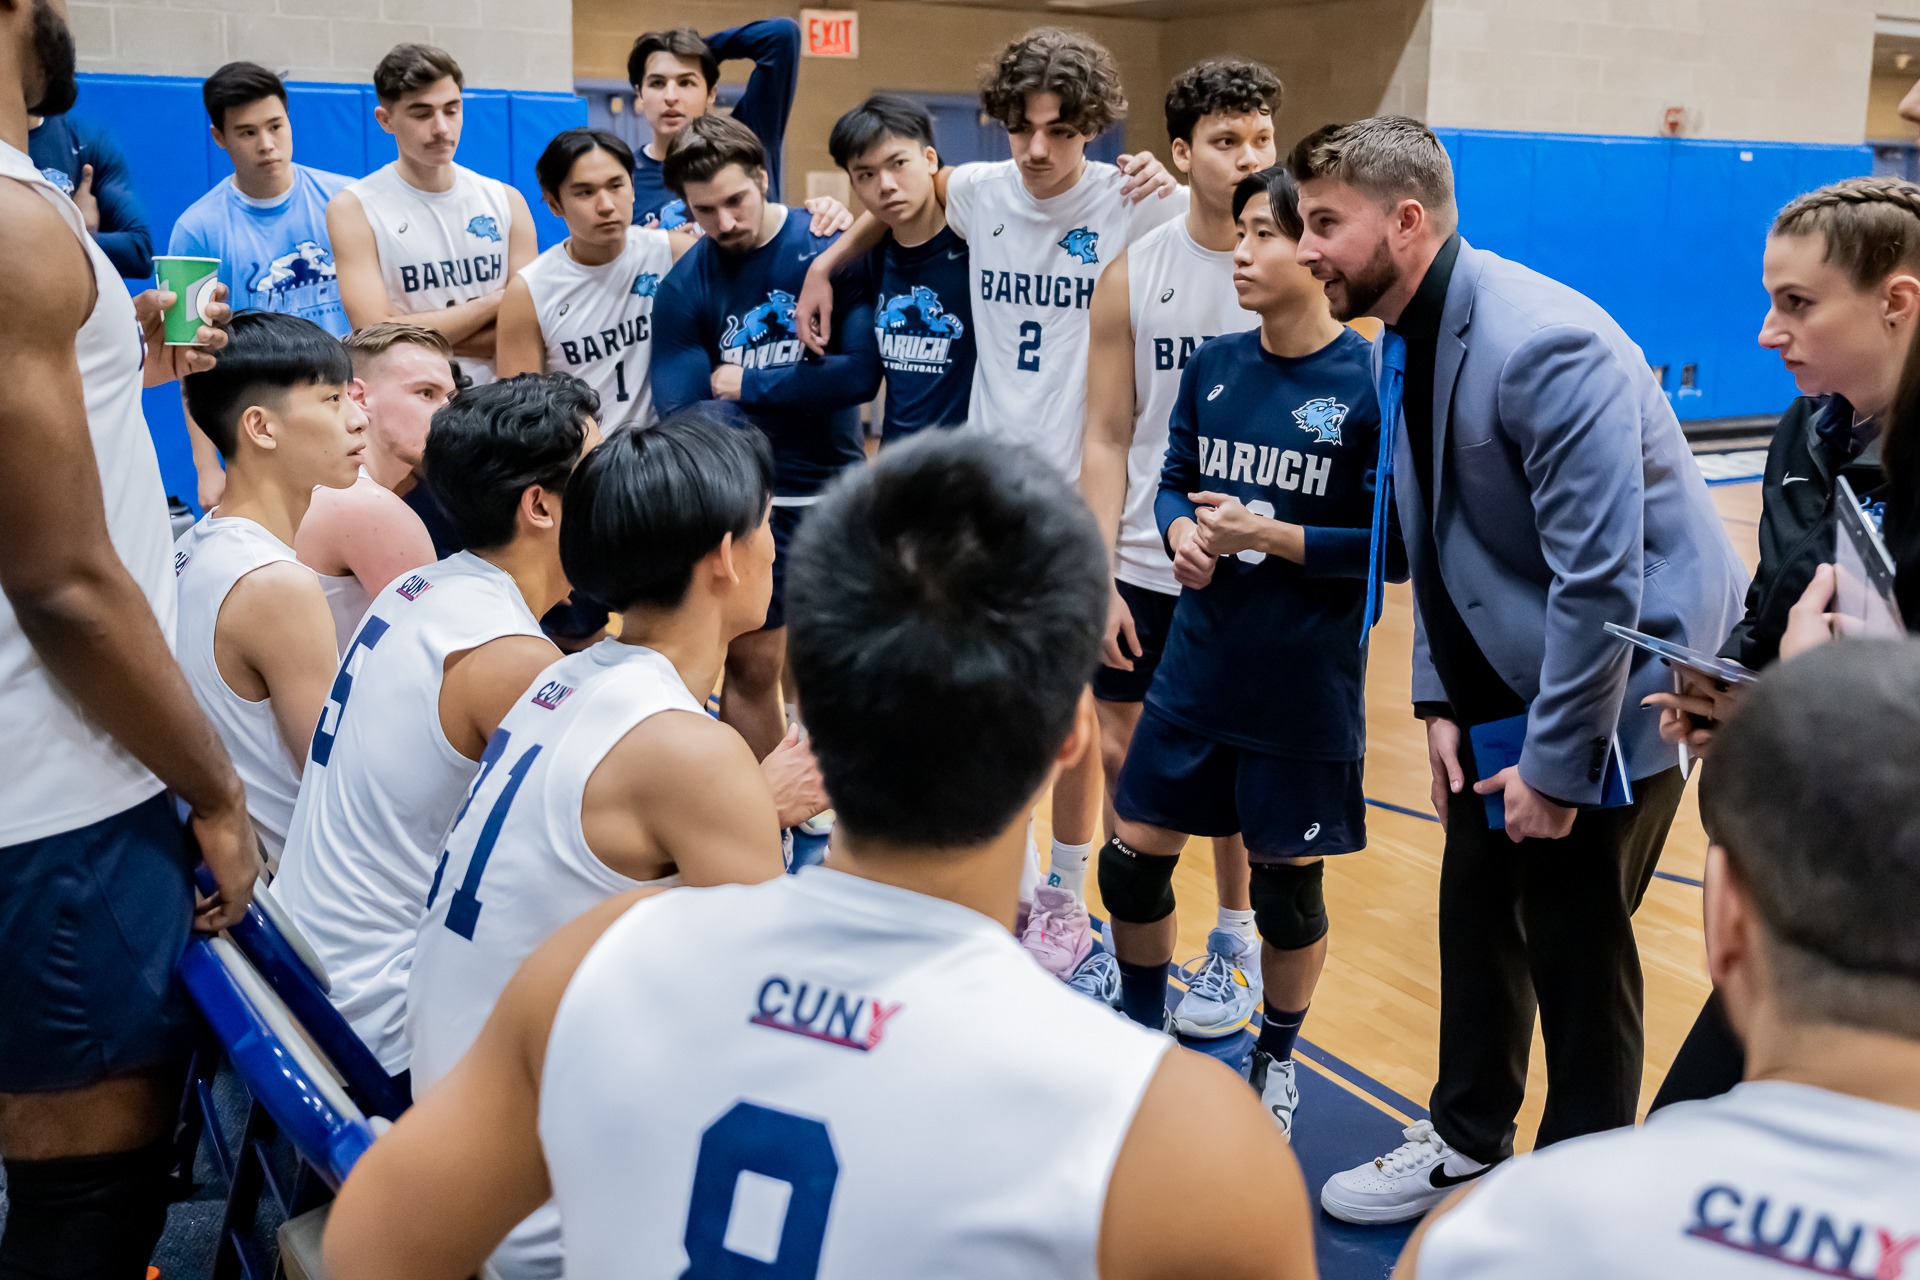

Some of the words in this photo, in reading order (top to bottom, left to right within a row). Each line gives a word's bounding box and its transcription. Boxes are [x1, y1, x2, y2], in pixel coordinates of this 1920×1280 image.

[808, 18, 851, 55] EXIT
[400, 254, 502, 293] BARUCH
[980, 269, 1095, 310] BARUCH
[560, 313, 652, 366] BARUC
[1017, 320, 1042, 372] 2
[1152, 335, 1217, 370] BA
[615, 360, 629, 402] 1
[889, 362, 944, 374] VOLLEYBALL
[1197, 436, 1332, 497] BARUCH
[396, 575, 434, 602] CUNY
[531, 680, 577, 710] CUNY
[750, 976, 904, 1052] CUNY
[1686, 1185, 1920, 1280] CUNY
